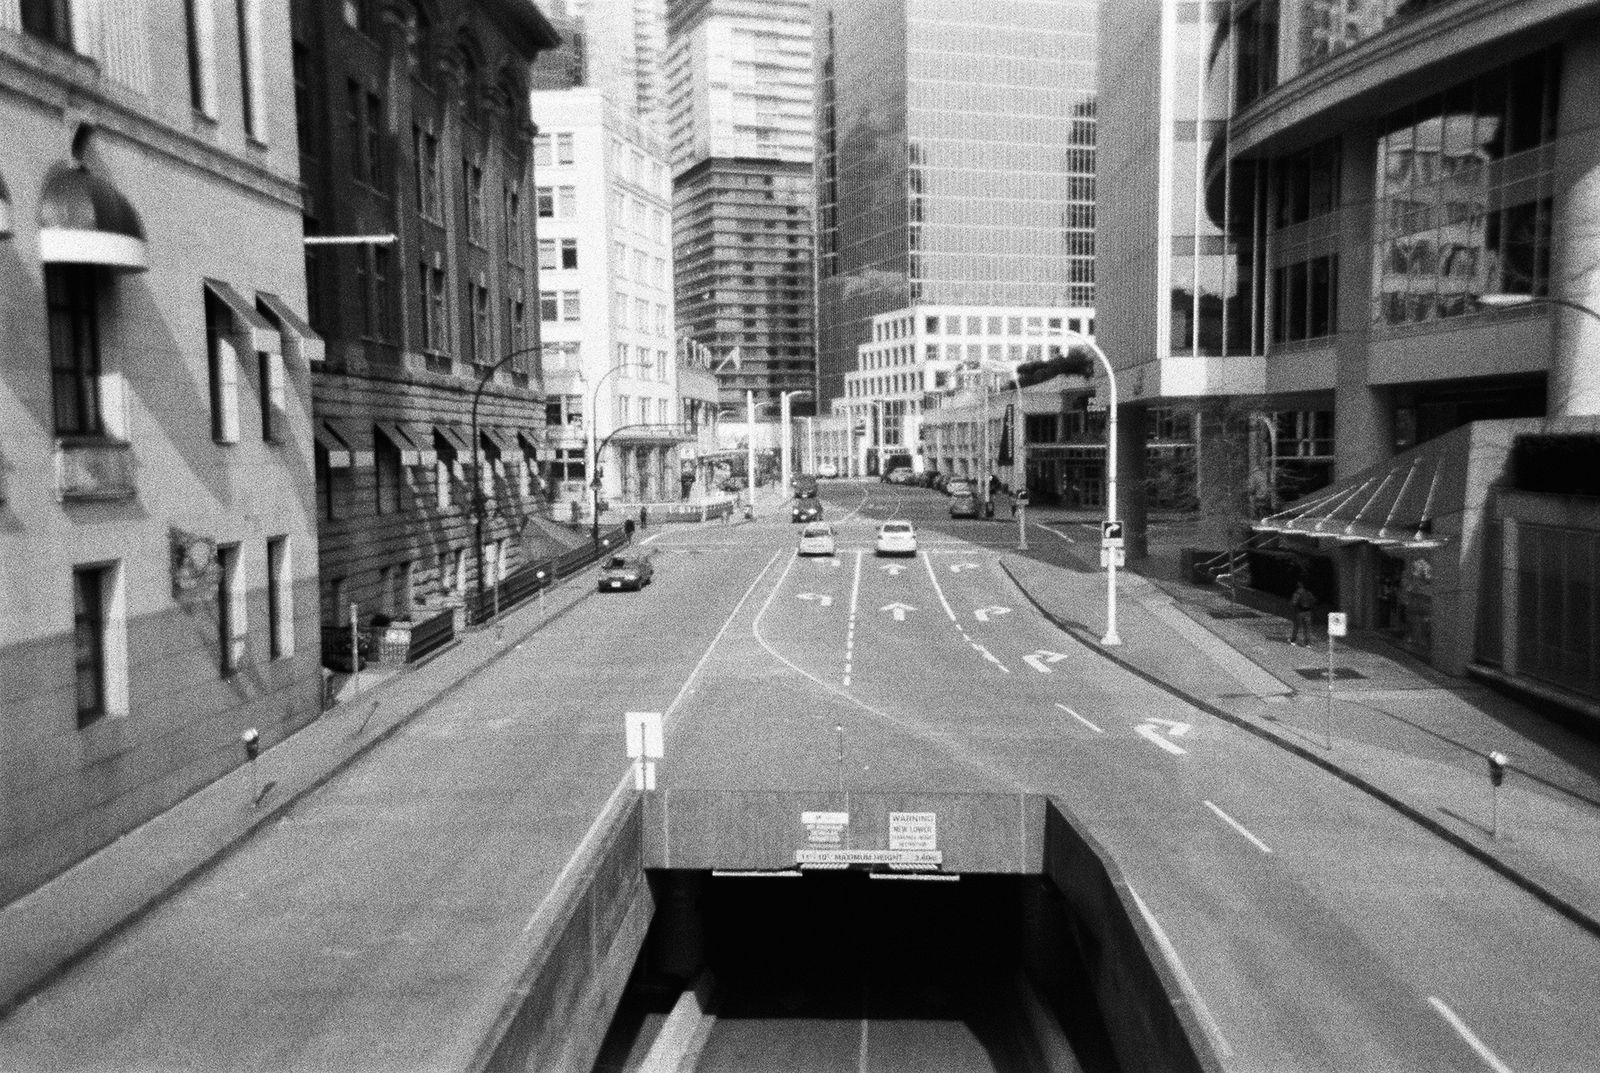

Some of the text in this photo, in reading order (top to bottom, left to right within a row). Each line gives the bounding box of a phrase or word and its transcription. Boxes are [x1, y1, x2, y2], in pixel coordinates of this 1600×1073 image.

[892, 814, 934, 822] WARNING
[834, 854, 872, 862] MAXIMUM
[873, 854, 902, 862] HEIGHT
